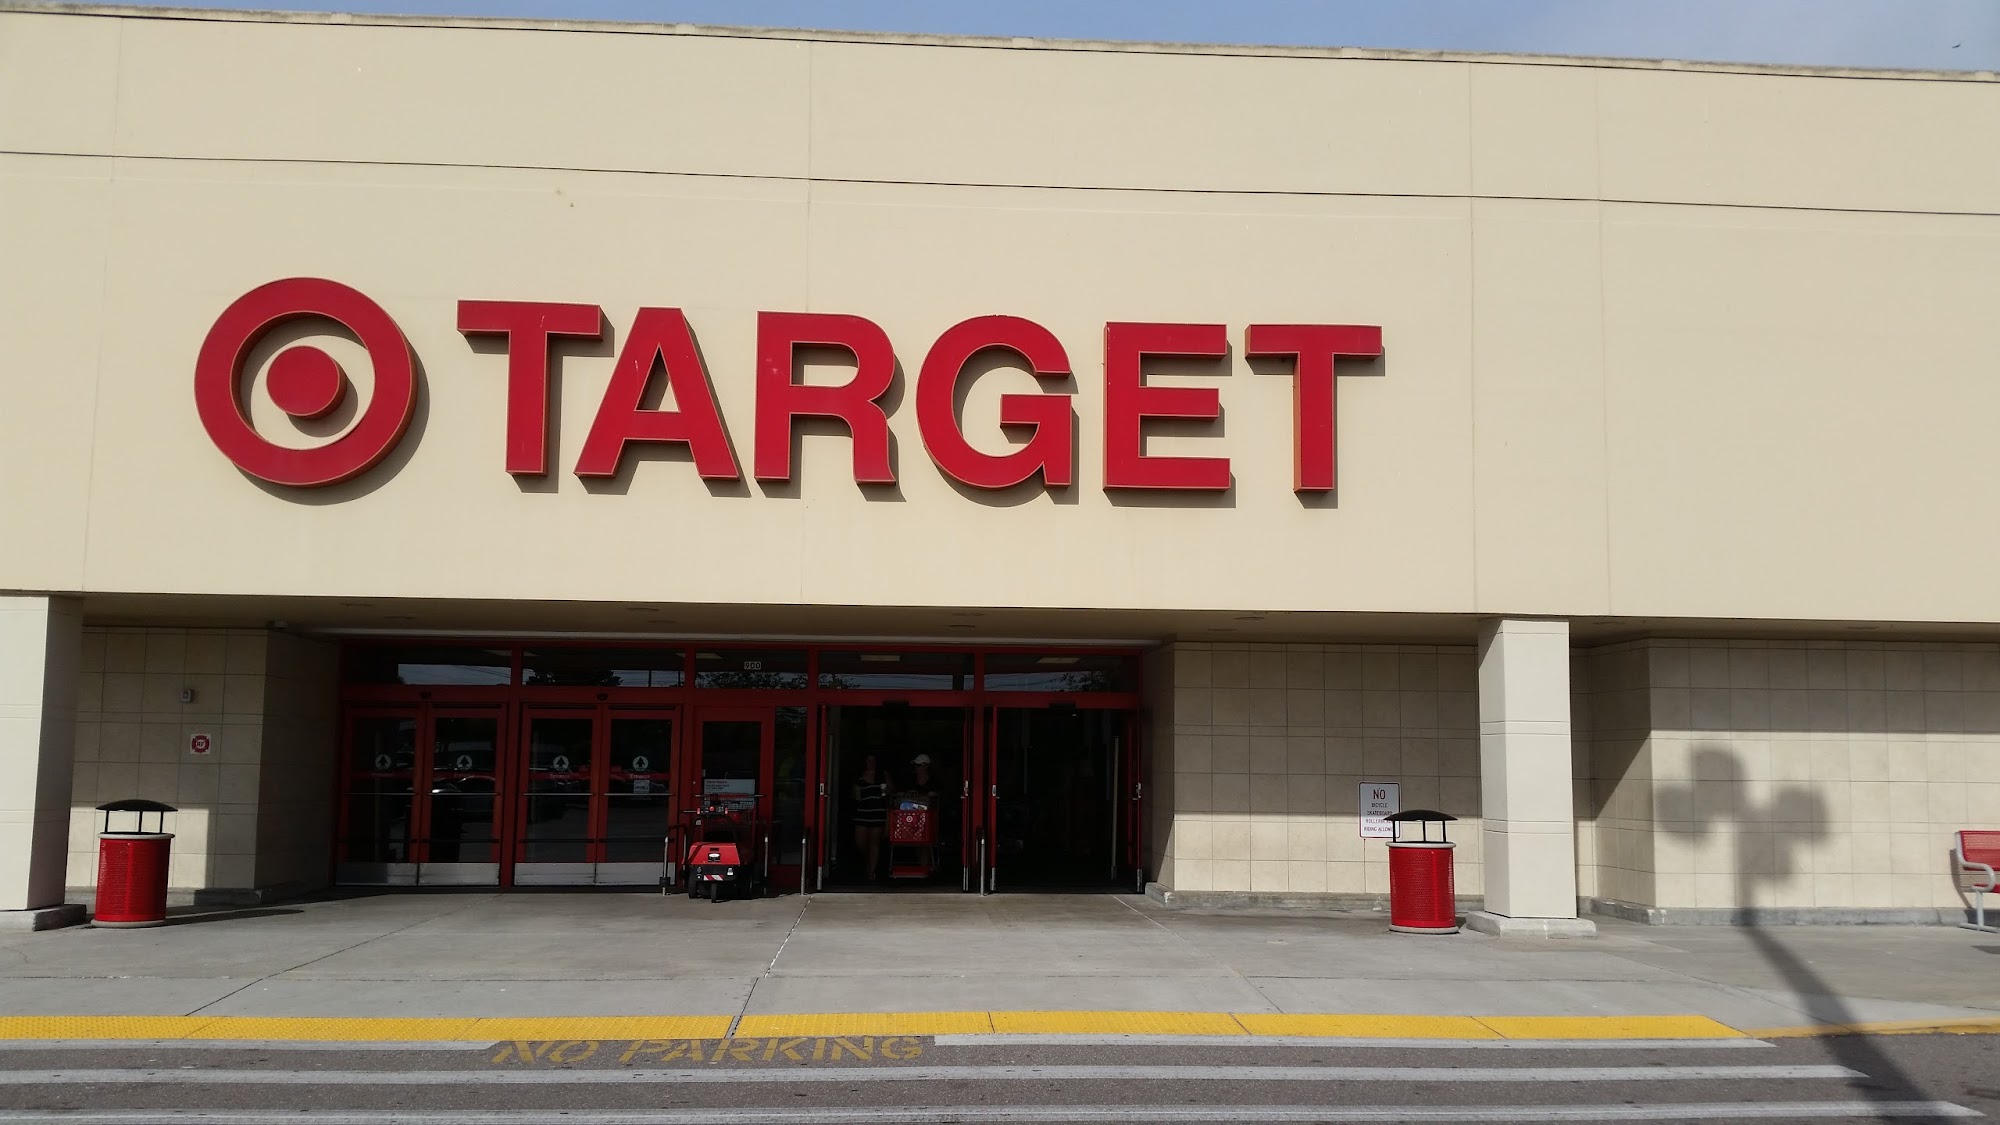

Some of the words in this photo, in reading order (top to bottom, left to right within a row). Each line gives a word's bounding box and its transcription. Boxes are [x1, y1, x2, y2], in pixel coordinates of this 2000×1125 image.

[457, 300, 1382, 493] TARGET
[1373, 789, 1386, 800] NO
[491, 1040, 598, 1063] NO
[618, 1036, 923, 1062] PARKING
